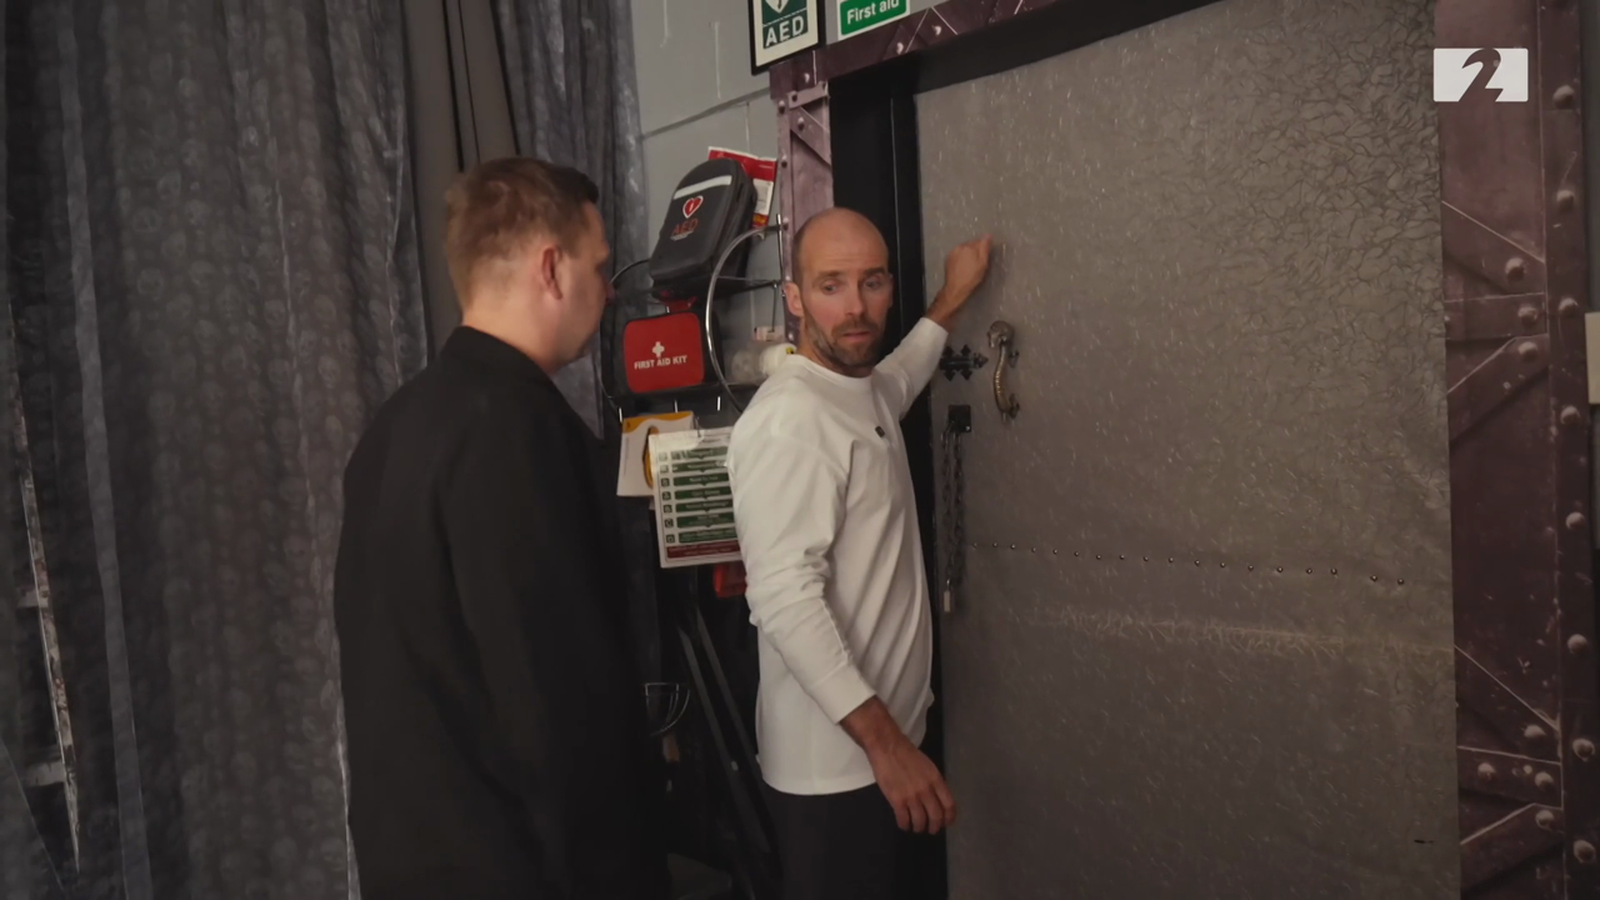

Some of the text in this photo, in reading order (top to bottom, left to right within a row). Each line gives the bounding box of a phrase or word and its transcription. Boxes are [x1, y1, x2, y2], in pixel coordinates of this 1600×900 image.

[847, 2, 876, 24] First
[765, 16, 804, 47] AED
[633, 355, 688, 370] FIRST AID KIT
